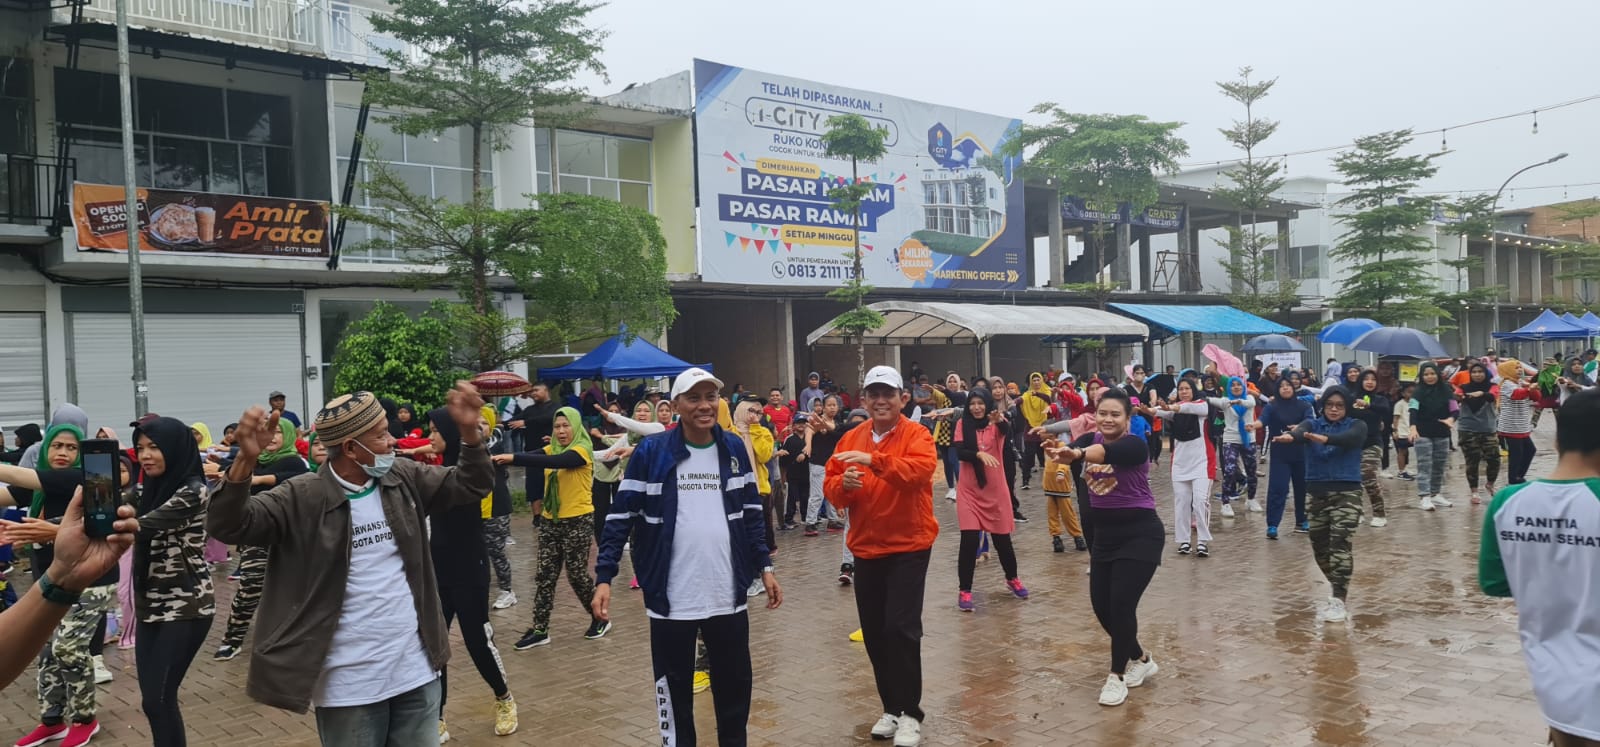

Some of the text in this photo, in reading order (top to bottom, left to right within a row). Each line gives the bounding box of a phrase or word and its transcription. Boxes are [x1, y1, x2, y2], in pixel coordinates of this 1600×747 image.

[761, 82, 800, 98] TELAH
[773, 133, 803, 147] RUKO
[769, 146, 793, 154] COCOK
[794, 149, 816, 157] UNTUK
[762, 162, 816, 175] DIMERIAHKAN
[747, 174, 890, 203] PASAR MAM
[90, 202, 144, 215] OPENIG
[223, 201, 309, 223] Amir
[730, 200, 801, 221] PASAR
[1148, 208, 1177, 220] GRATIS
[102, 213, 127, 223] SOO
[230, 221, 324, 244] Prata
[785, 229, 853, 242] SETIAP MINGGU
[788, 264, 865, 280] 0813 2111 131
[934, 270, 1006, 281] MARKETING OFFICE
[1515, 516, 1578, 529] PANITIA
[352, 531, 393, 548] GOTA DPRD
[1500, 530, 1551, 543] SENAM
[657, 686, 669, 730] DPRD
